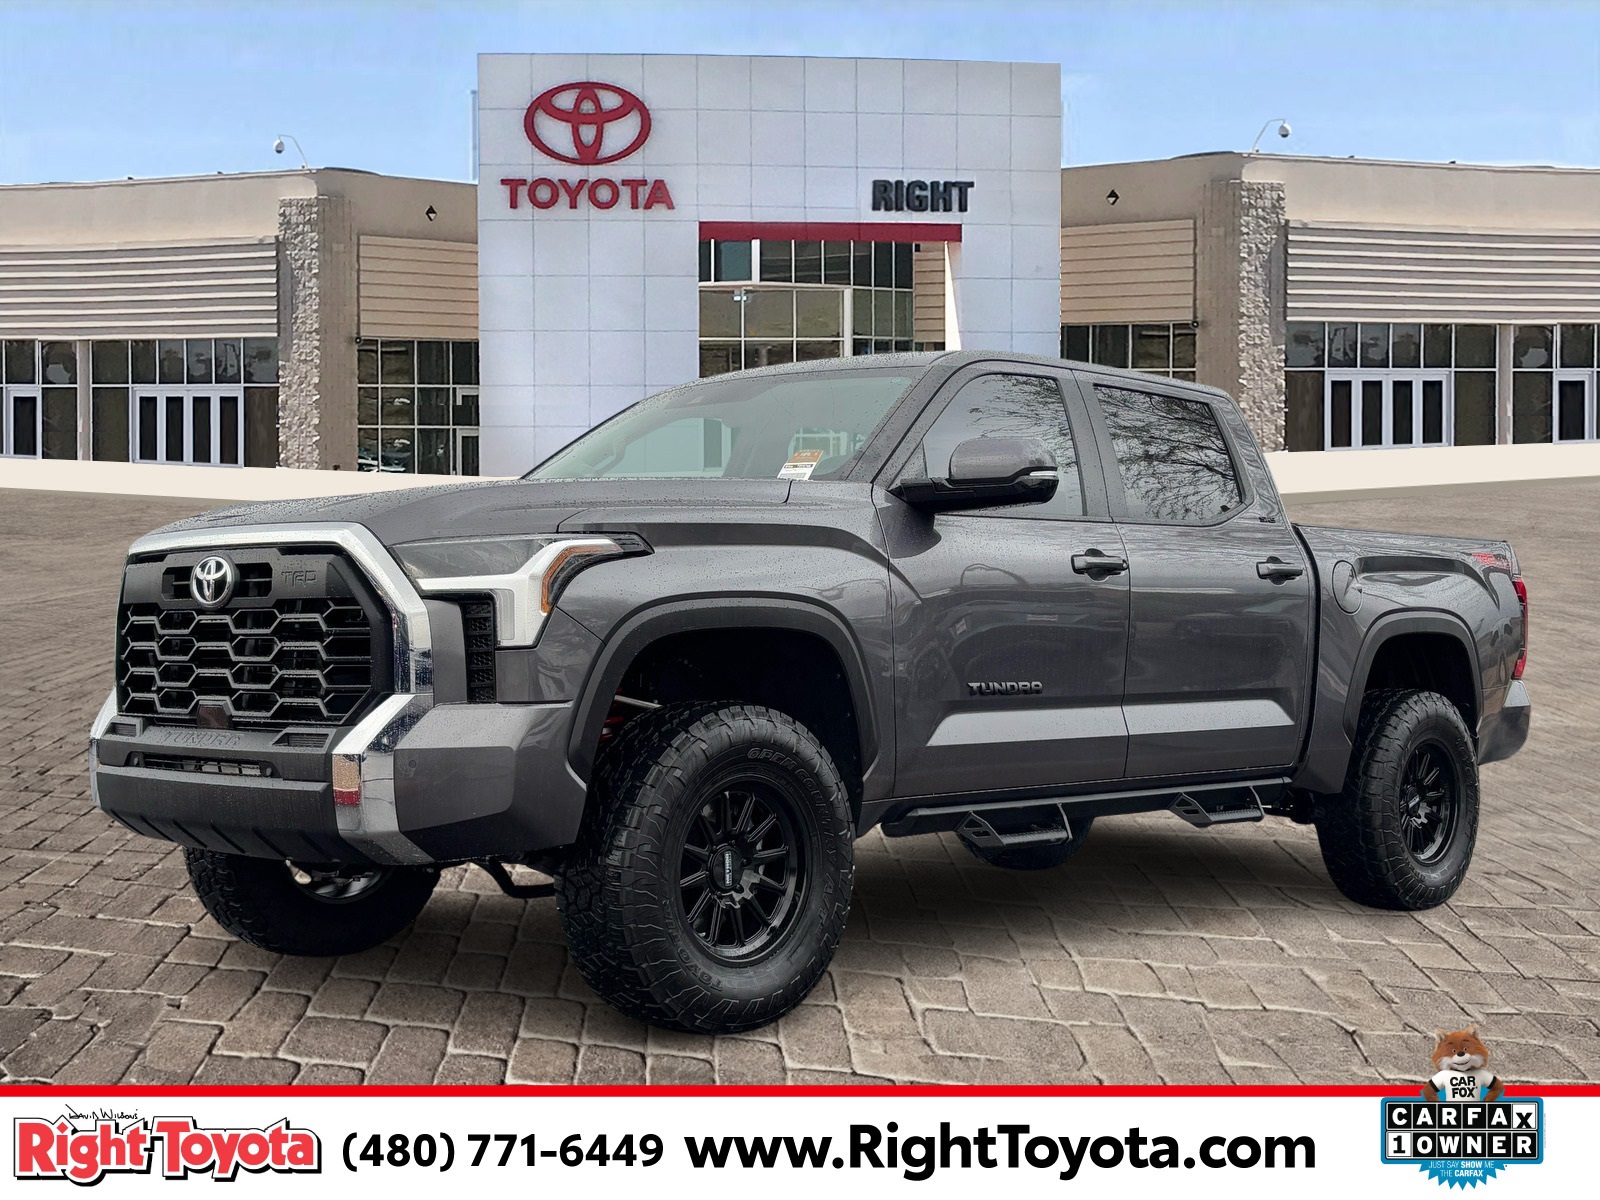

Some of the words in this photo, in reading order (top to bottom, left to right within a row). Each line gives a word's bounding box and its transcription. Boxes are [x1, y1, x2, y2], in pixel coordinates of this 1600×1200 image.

[501, 179, 674, 210] TOYOTA
[871, 180, 975, 213] RIGHT
[967, 681, 1043, 695] TUNDRA
